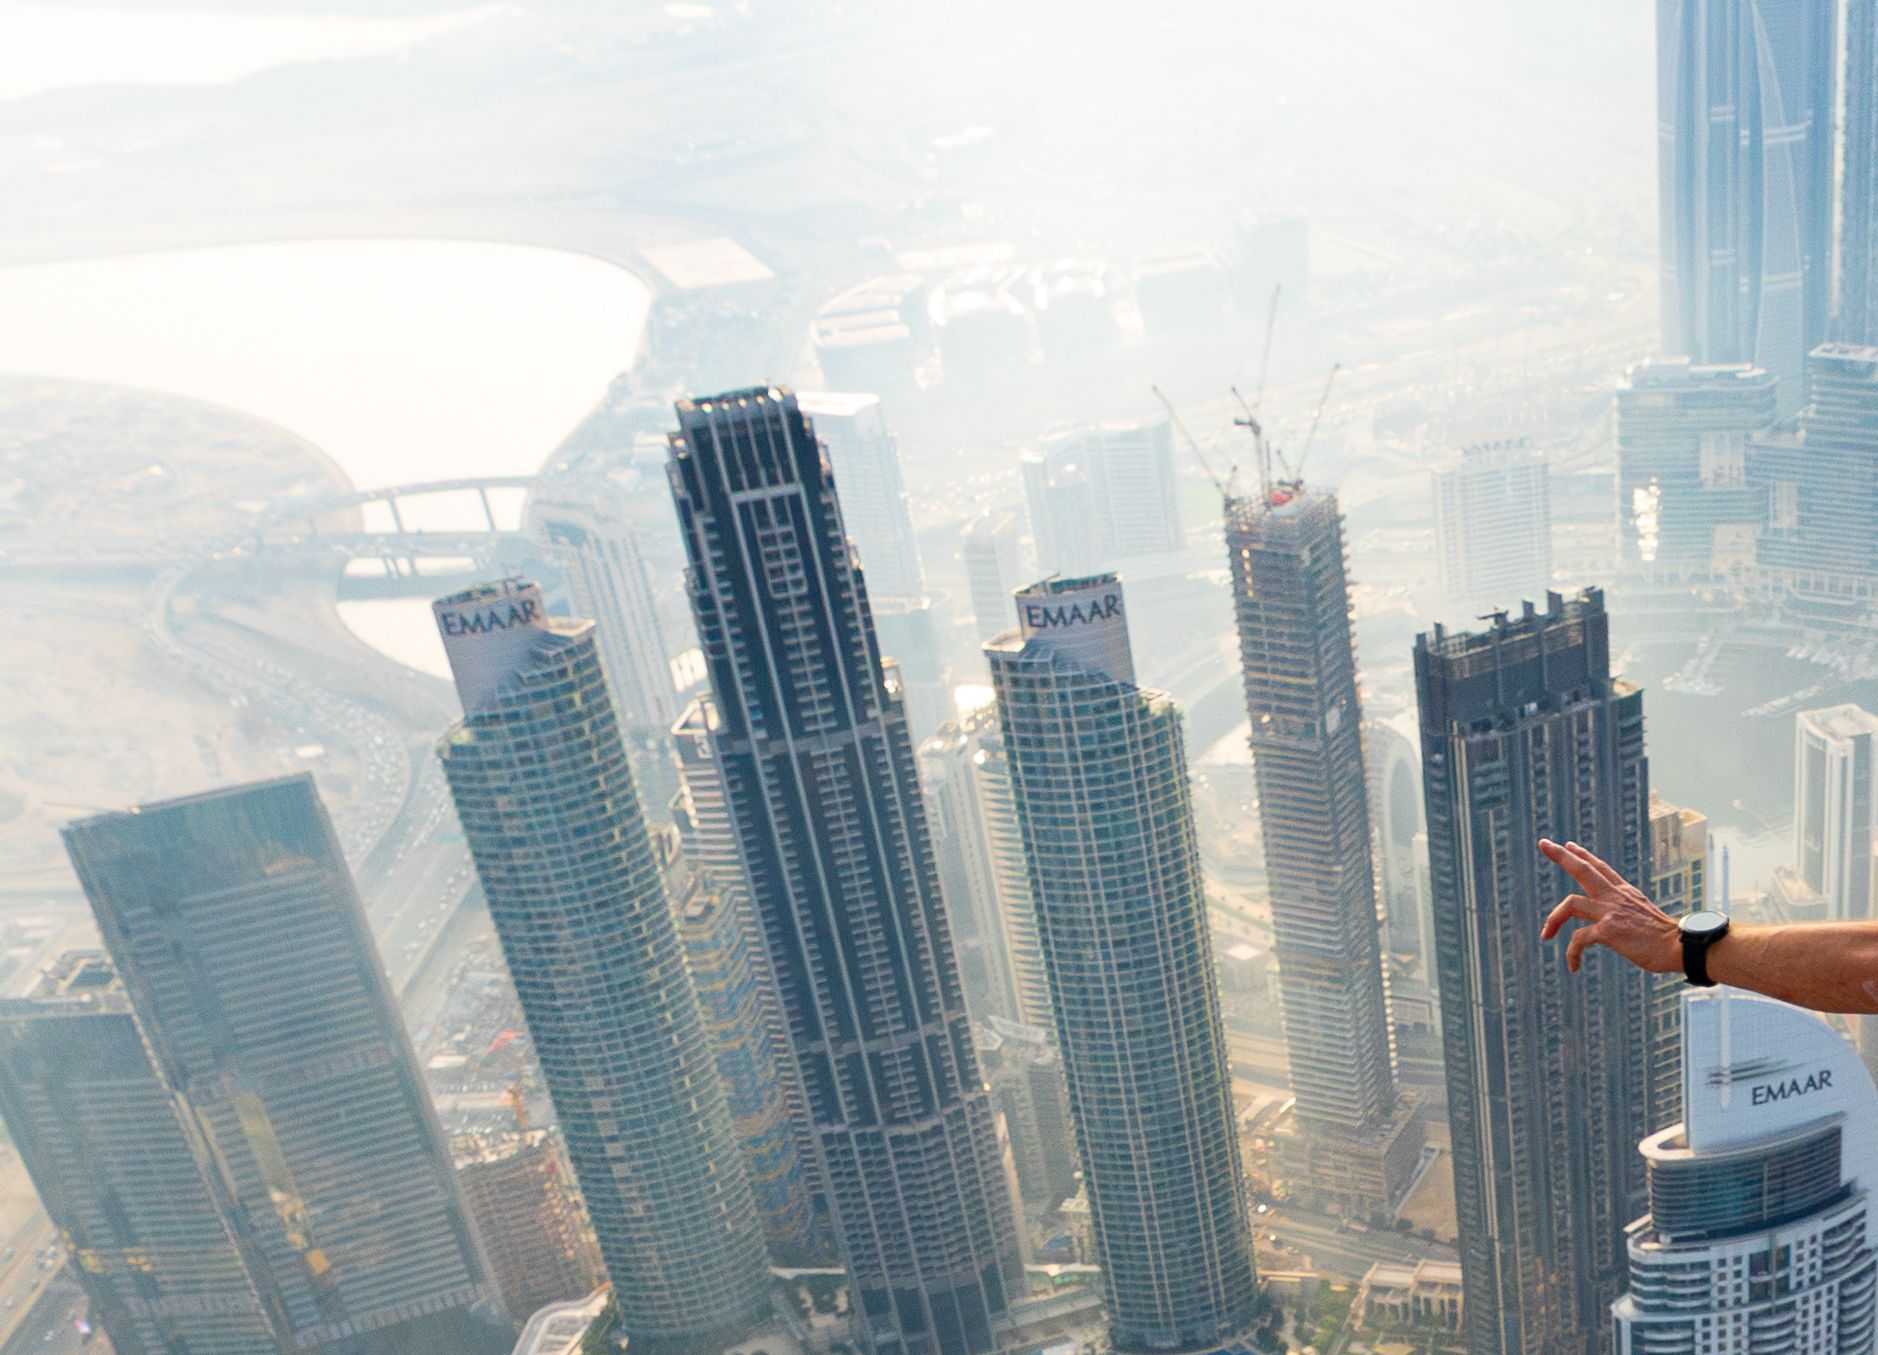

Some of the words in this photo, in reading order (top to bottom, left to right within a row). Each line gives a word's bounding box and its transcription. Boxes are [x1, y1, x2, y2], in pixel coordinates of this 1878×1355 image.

[442, 599, 541, 636] EMAAR
[1026, 593, 1122, 628] EMAAR
[1752, 1070, 1833, 1106] EMAAR
